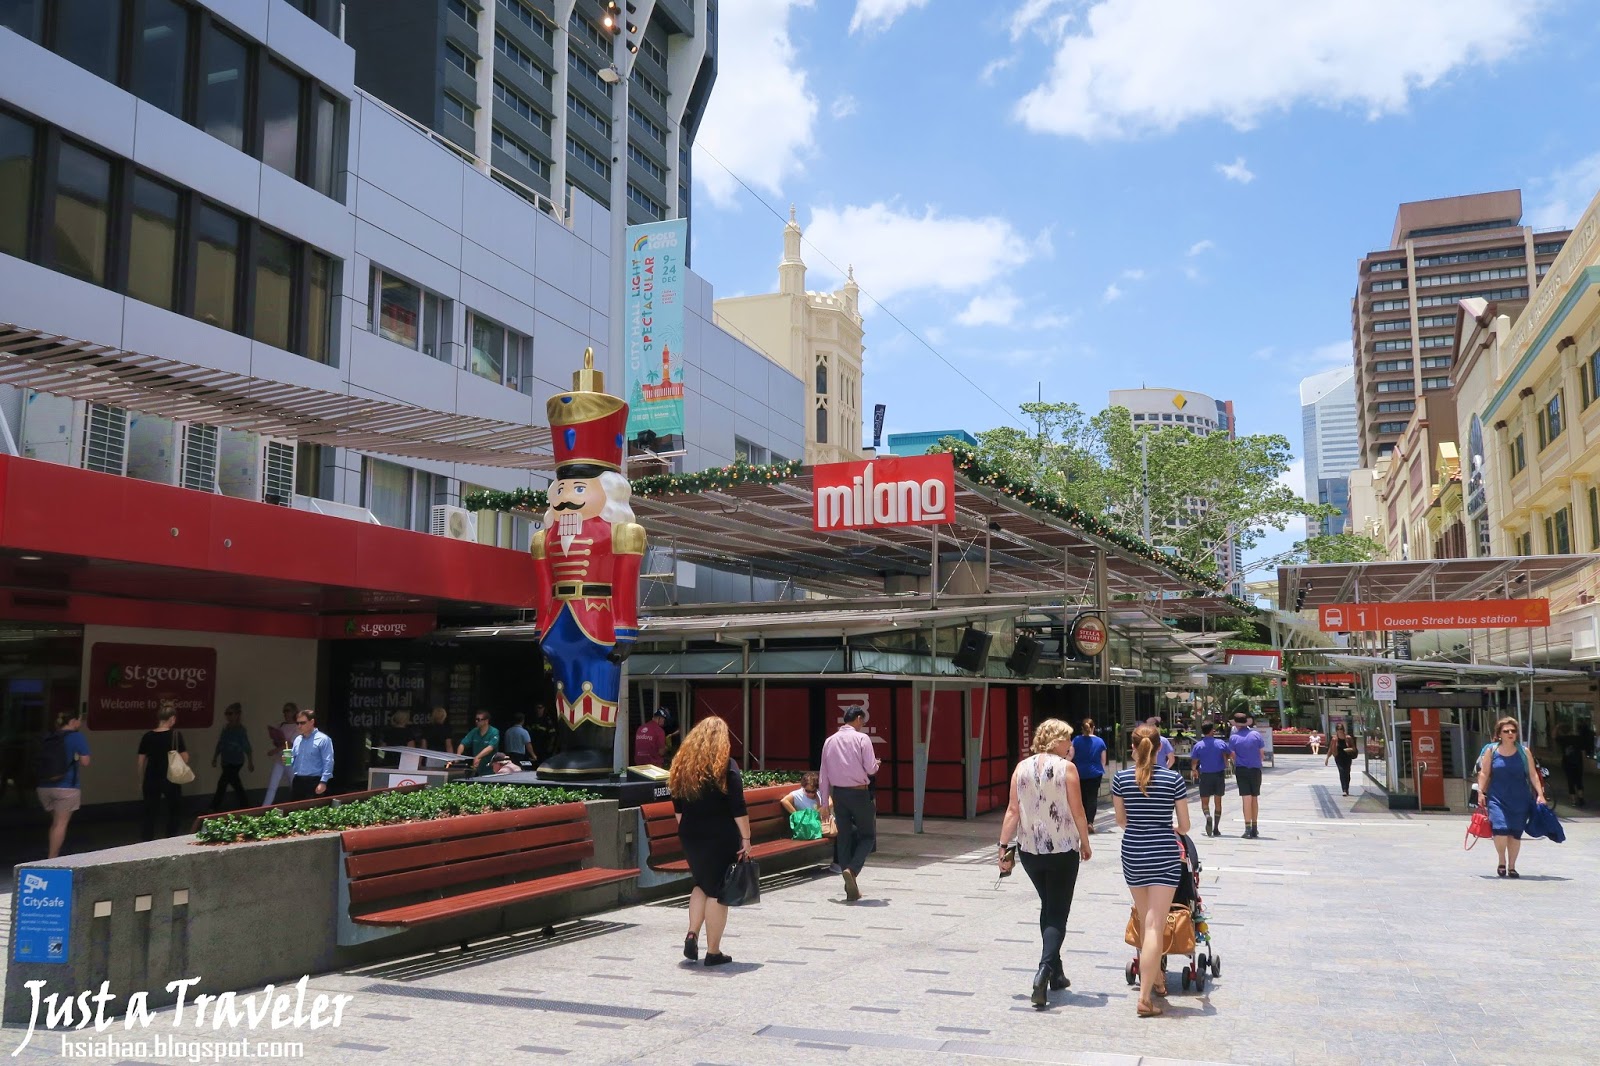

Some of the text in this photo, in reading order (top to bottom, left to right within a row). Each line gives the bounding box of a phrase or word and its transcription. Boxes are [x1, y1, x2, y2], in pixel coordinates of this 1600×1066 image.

[648, 238, 678, 250] LOTTO
[662, 264, 676, 275] 24
[642, 256, 655, 351] SPECTACULAR
[632, 302, 641, 338] HALL
[631, 342, 640, 370] CITY
[817, 461, 947, 528] milano
[1357, 611, 1518, 627] 1 Queen Street bus station
[361, 623, 407, 637] st.george
[1079, 629, 1100, 637] STELLA
[124, 665, 207, 689] st.george
[386, 673, 425, 690] Queen
[100, 698, 145, 709] Welcome
[147, 699, 157, 709] to
[386, 690, 413, 707] Mall
[1021, 715, 1030, 758] ilano
[23, 896, 65, 910] CitySafe
